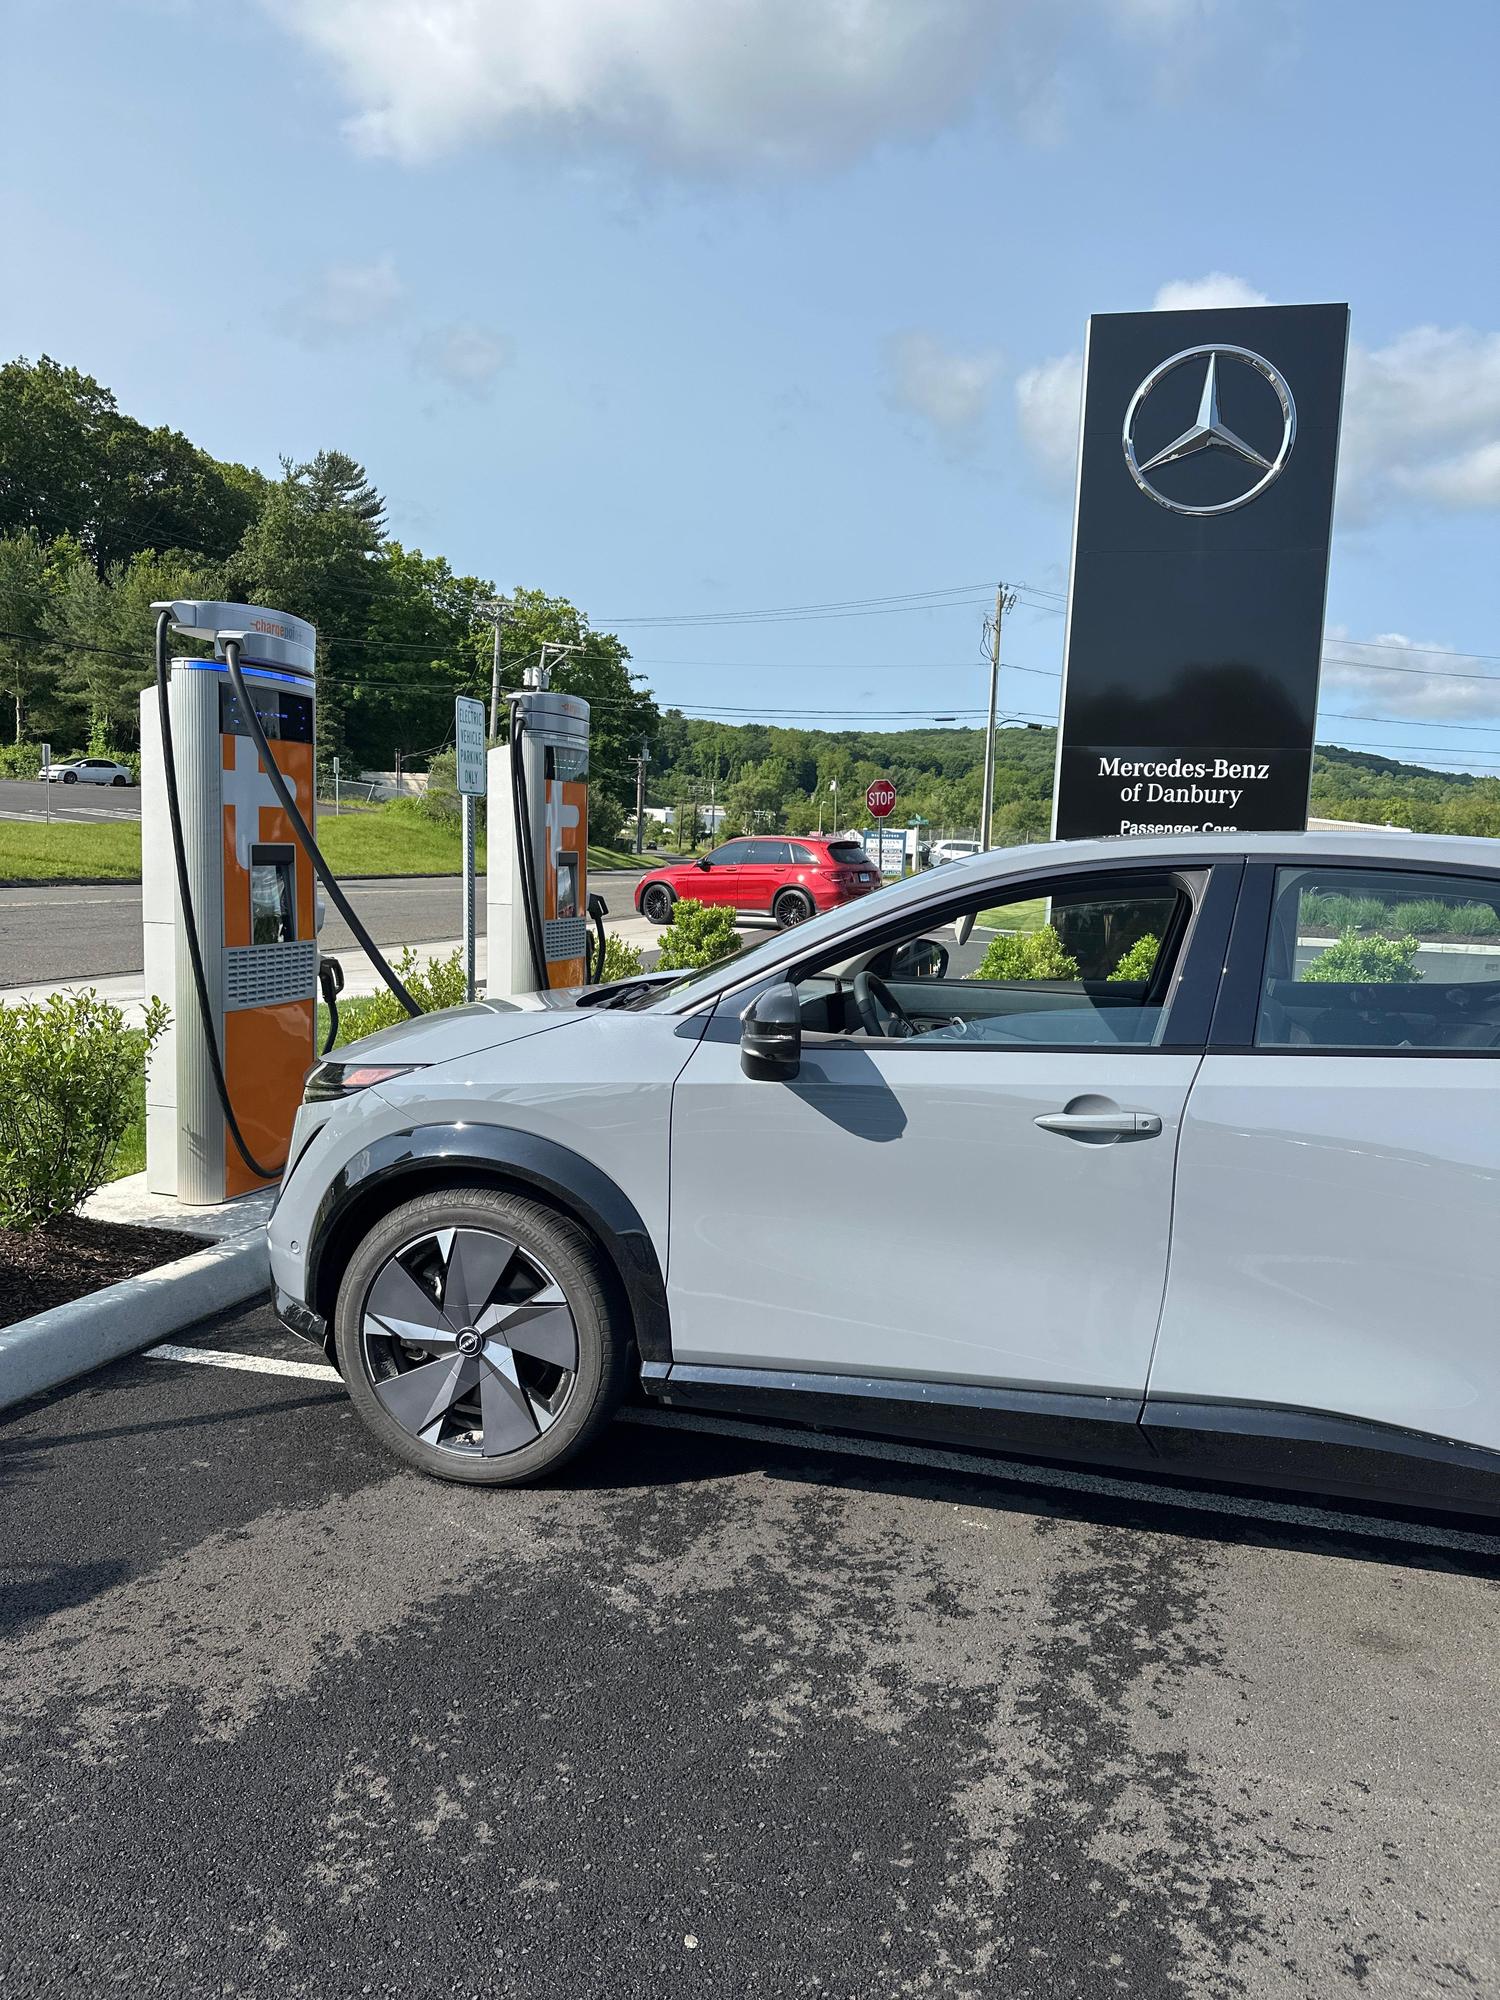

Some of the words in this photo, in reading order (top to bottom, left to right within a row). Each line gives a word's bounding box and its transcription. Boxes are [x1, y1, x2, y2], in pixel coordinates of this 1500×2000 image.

[255, 619, 303, 641] chargepoi
[459, 708, 482, 726] ELECTRIC
[460, 729, 482, 746] VEHICLE
[460, 749, 482, 766] PARKING
[464, 769, 479, 785] ONLY
[1098, 757, 1270, 780] Mercedes-Benz
[868, 791, 895, 806] STOP
[1120, 783, 1143, 802] of
[1147, 783, 1243, 809] Danbury
[1120, 820, 1199, 836] Passenger
